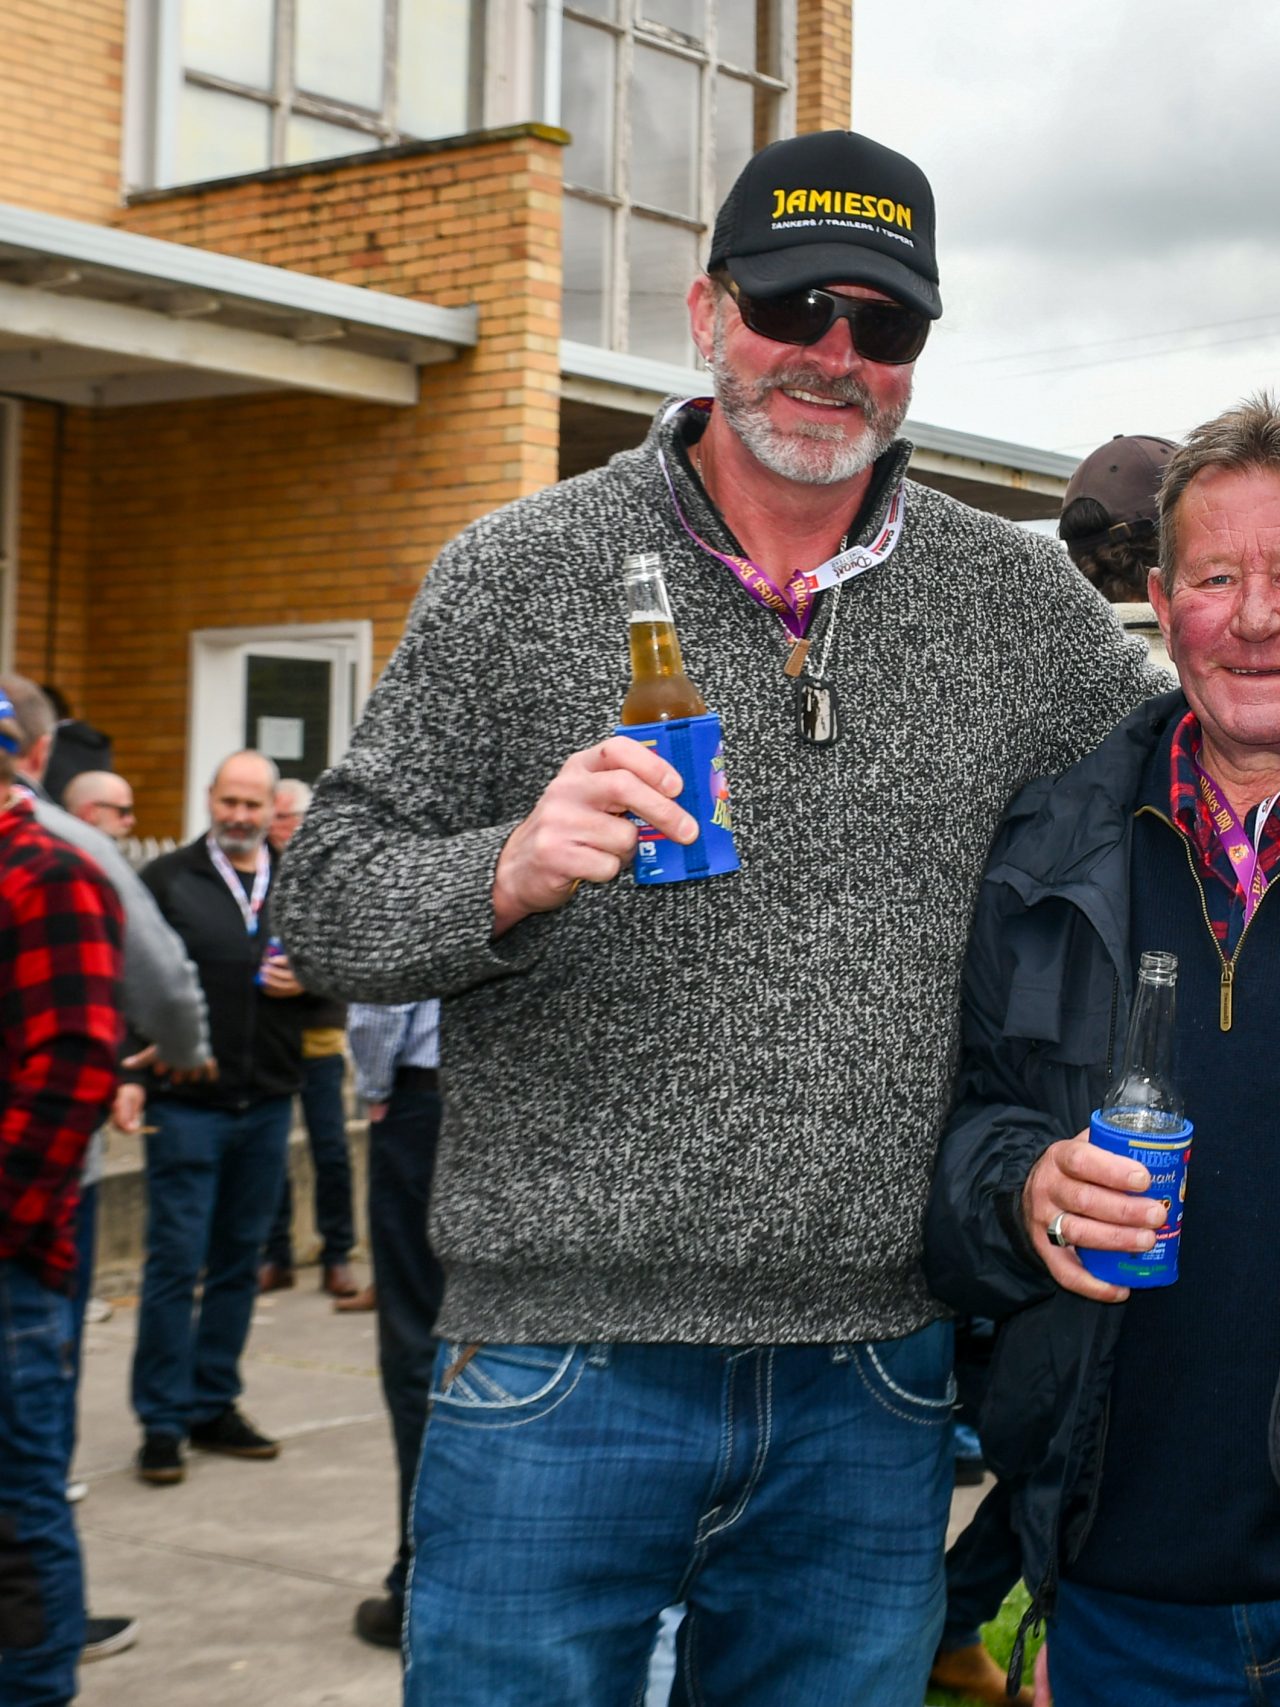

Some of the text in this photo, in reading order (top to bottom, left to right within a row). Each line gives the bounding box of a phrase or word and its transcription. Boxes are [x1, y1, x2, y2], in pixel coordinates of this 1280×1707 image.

[772, 189, 912, 231] JAMIESON
[771, 219, 816, 230] TANKERS
[825, 219, 874, 231] TRAILERS
[882, 228, 914, 248] TIPPERS
[832, 555, 873, 578] Duart
[1200, 775, 1235, 836] Blokes BBQ
[1151, 1170, 1176, 1184] uart
